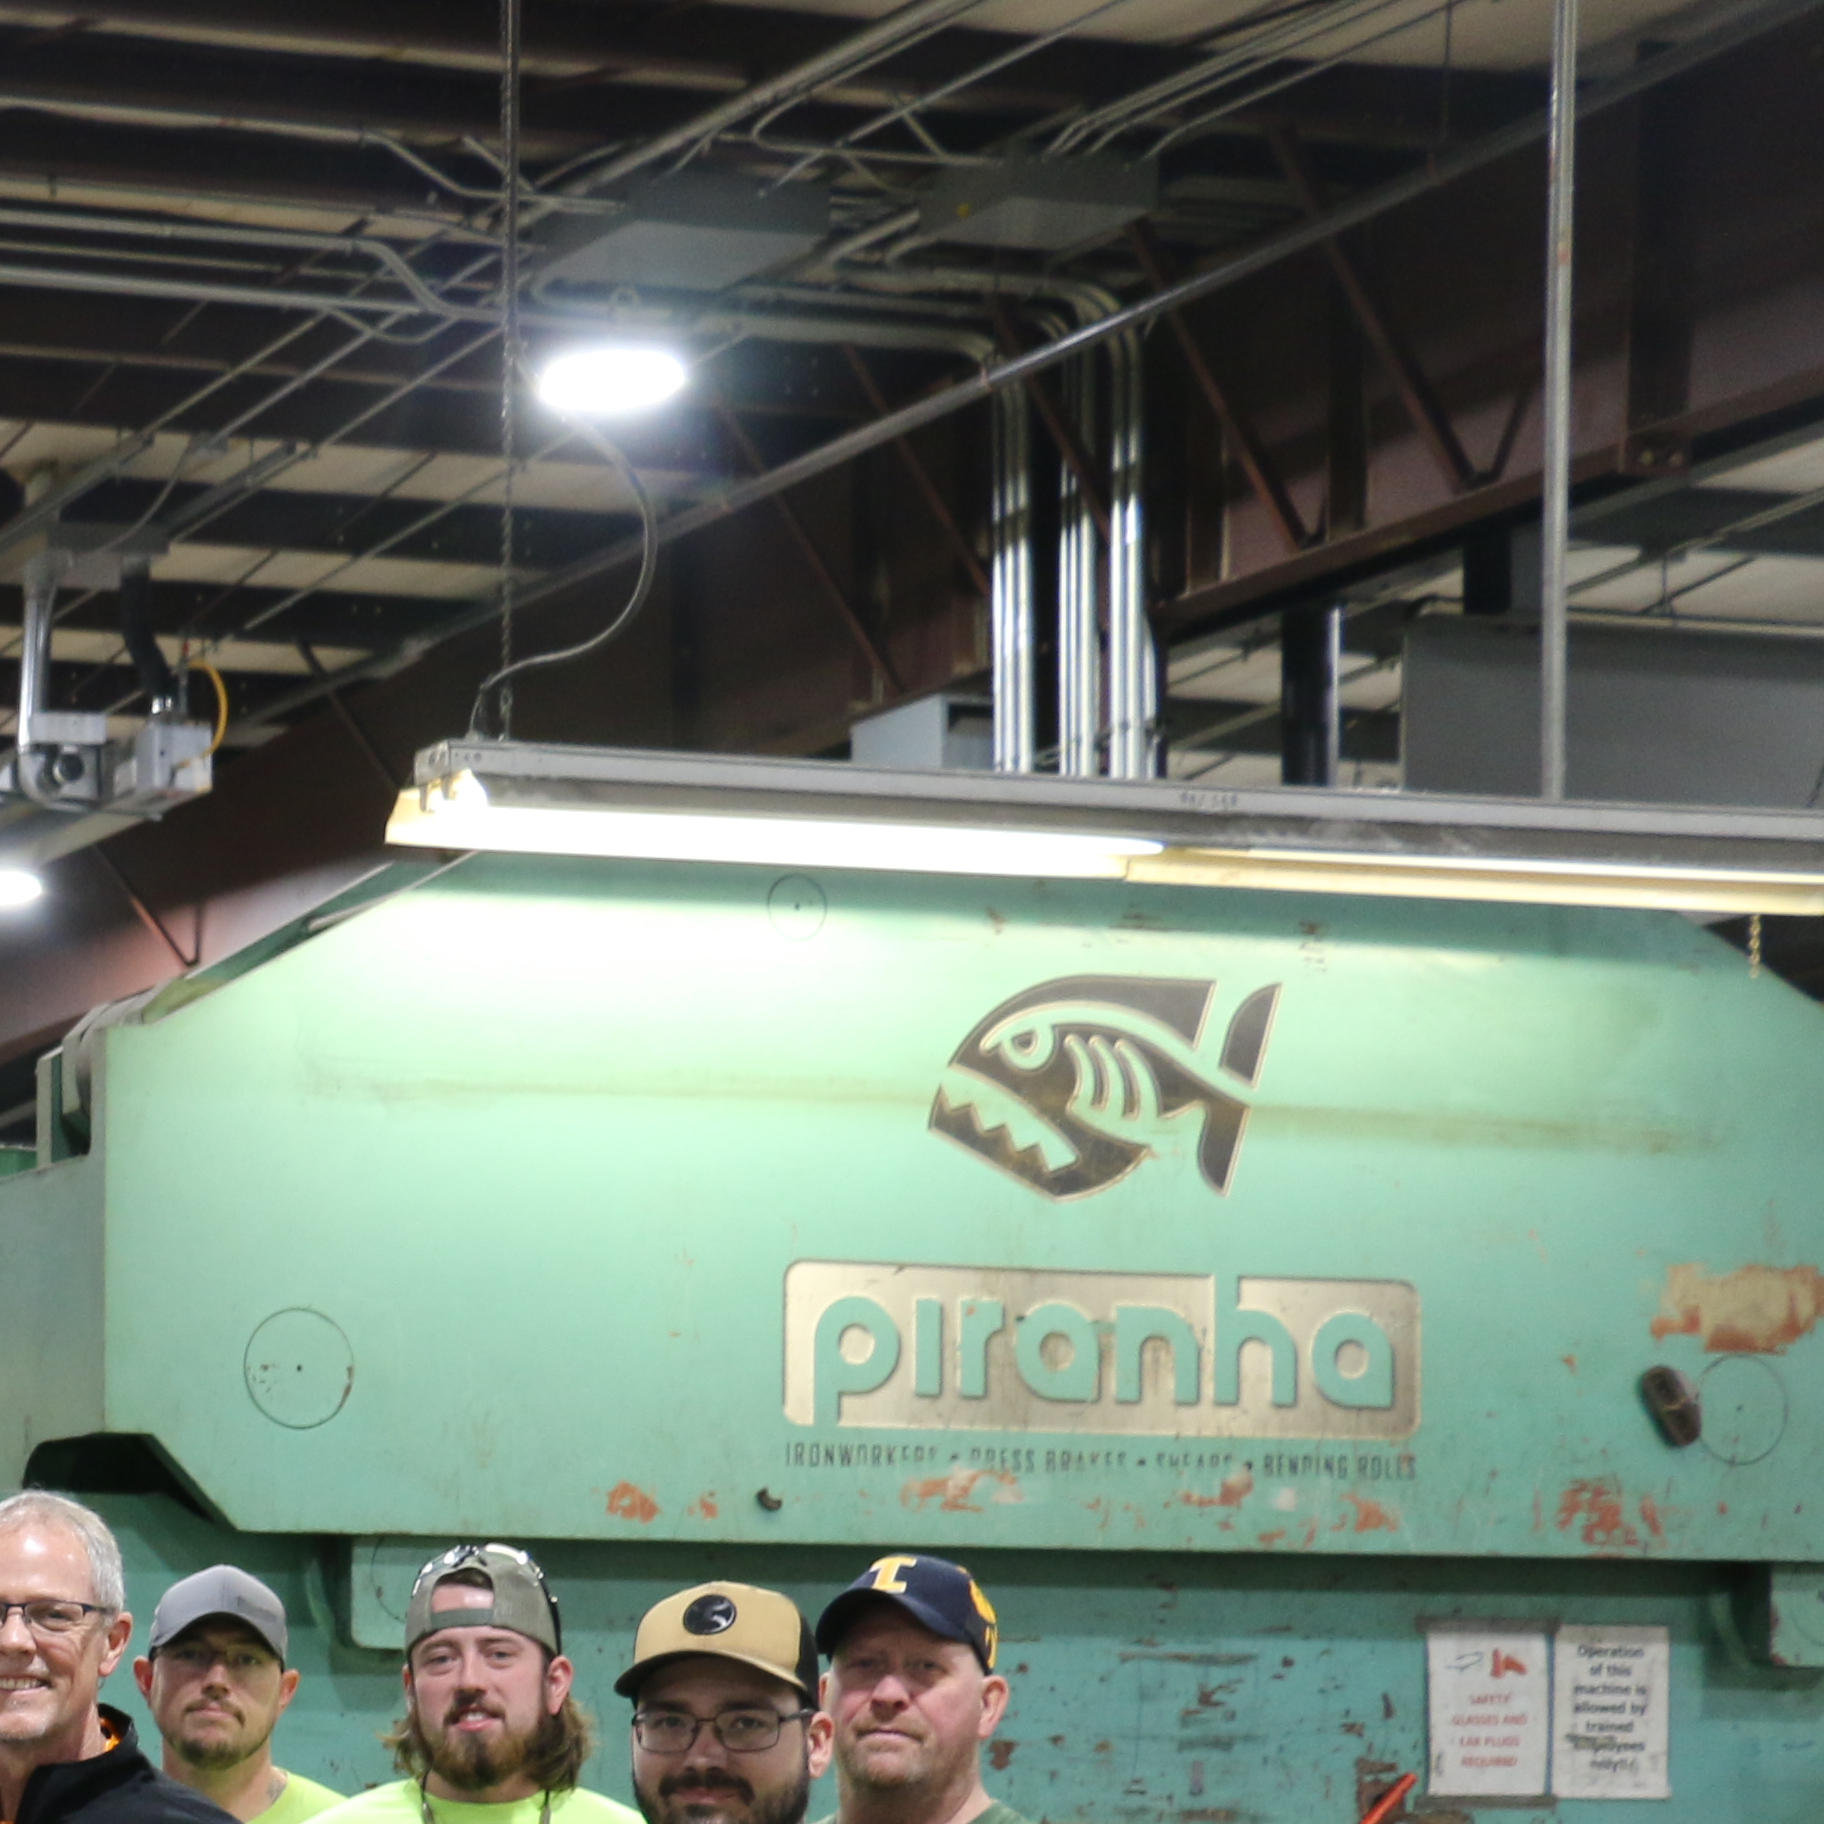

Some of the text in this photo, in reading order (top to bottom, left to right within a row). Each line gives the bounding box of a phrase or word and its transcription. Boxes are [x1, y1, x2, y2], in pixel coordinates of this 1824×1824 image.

[813, 1275, 1394, 1427] piranha
[1577, 1645, 1644, 1660] Operation
[1590, 1664, 1632, 1677] of this
[1574, 1684, 1648, 1697] machine is
[1587, 1721, 1634, 1734] trained
